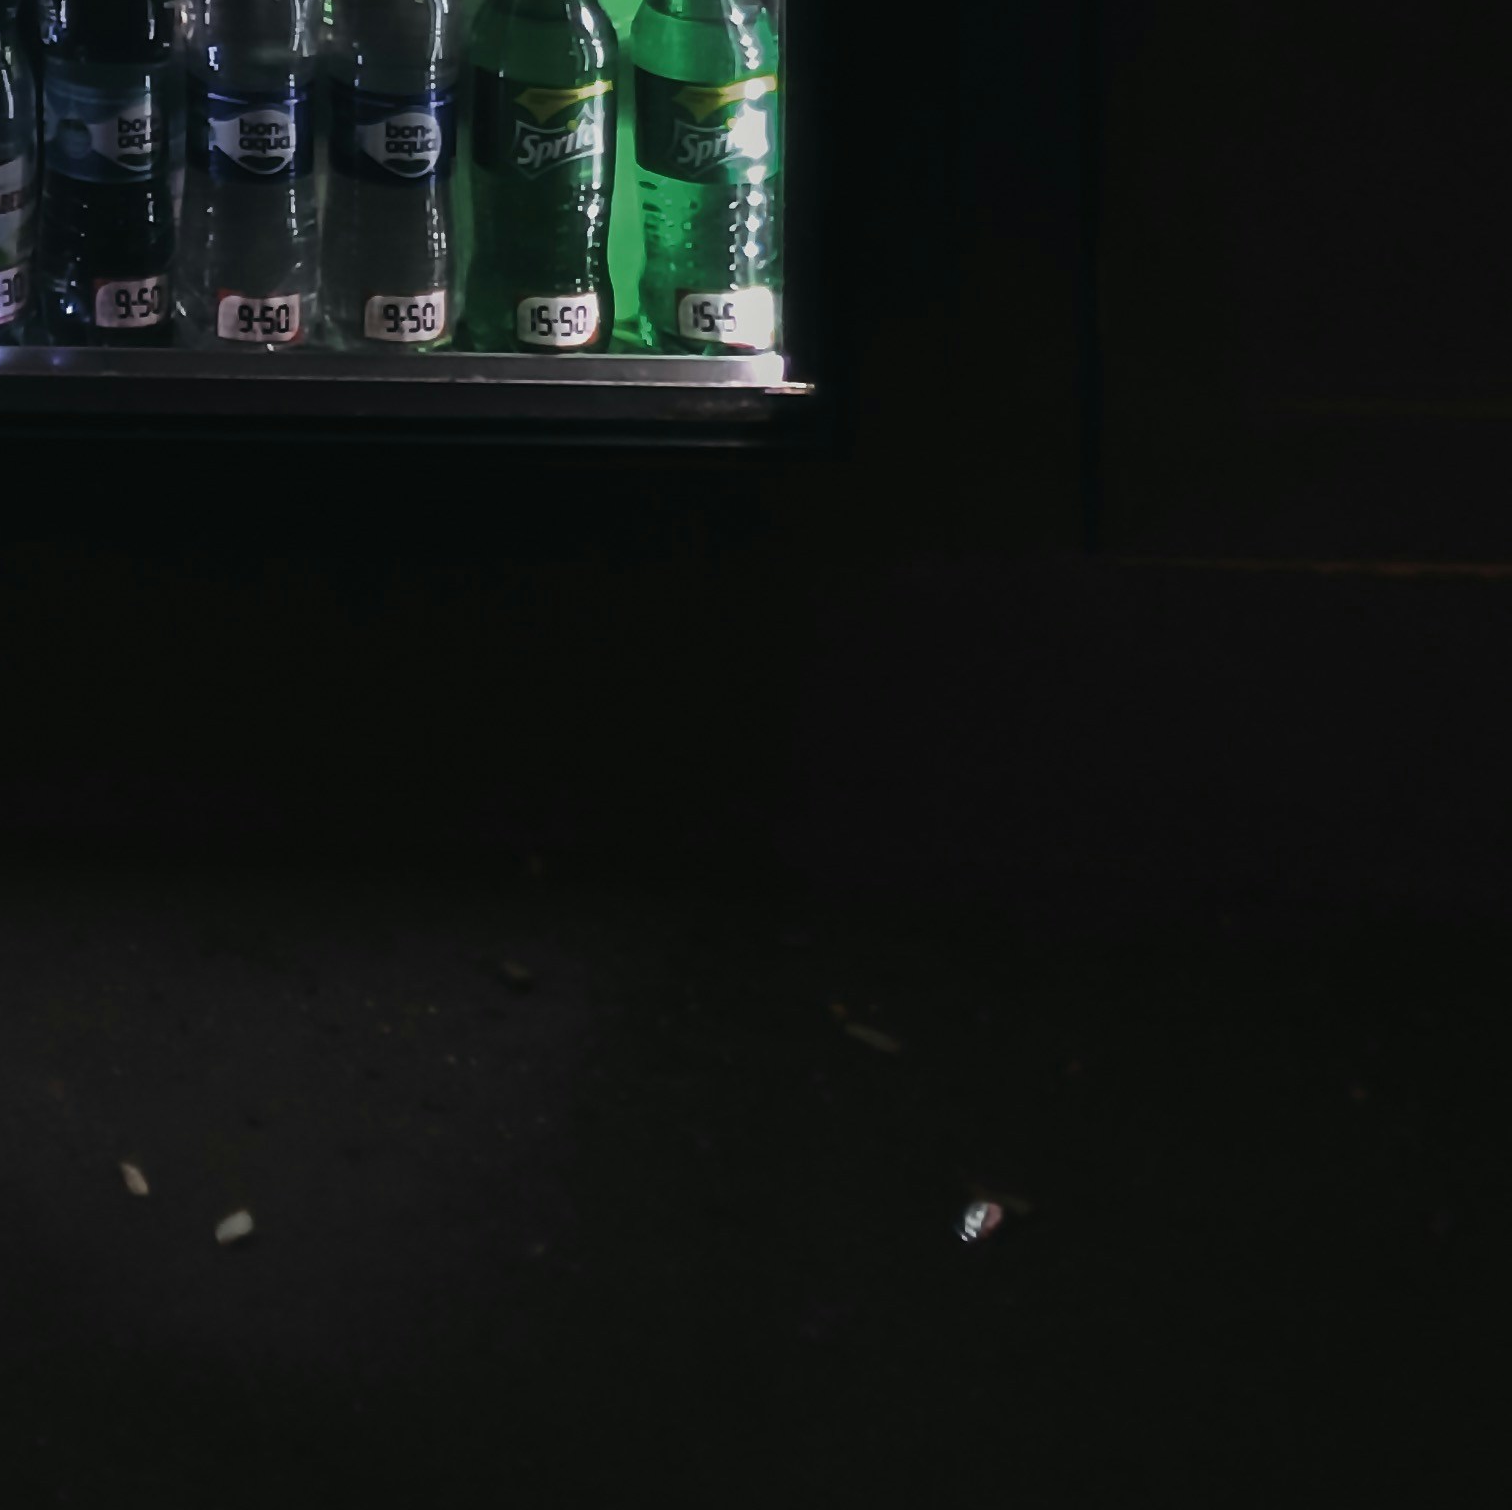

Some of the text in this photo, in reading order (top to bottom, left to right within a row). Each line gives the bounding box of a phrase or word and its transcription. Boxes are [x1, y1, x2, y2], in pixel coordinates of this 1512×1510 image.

[115, 283, 162, 319] 9-50
[692, 301, 737, 334] 15-5
[238, 302, 291, 334] 9-50
[383, 302, 436, 334] 9-50
[530, 304, 588, 337] 15-50
